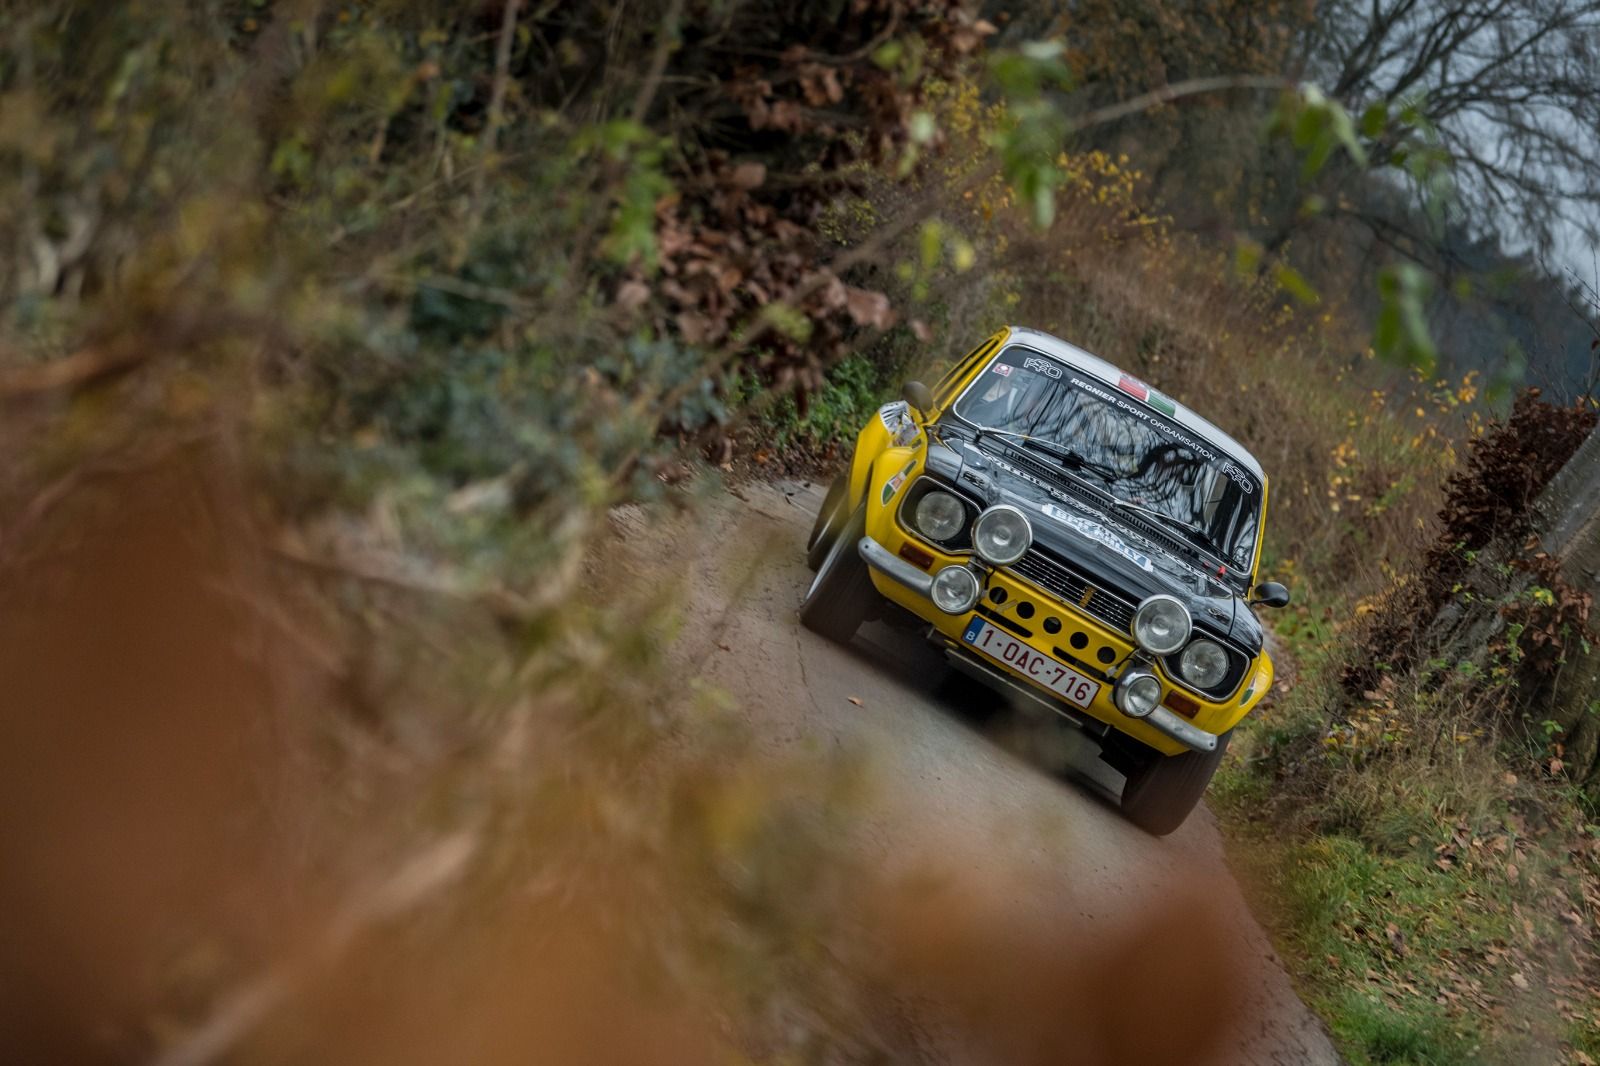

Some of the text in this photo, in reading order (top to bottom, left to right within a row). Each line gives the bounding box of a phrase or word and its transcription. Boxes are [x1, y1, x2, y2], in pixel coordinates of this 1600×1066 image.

[1070, 377, 1217, 462] REGNIER SPORT ORGANISATION
[965, 630, 976, 641] B
[982, 629, 1091, 701] 1-OAC-716
